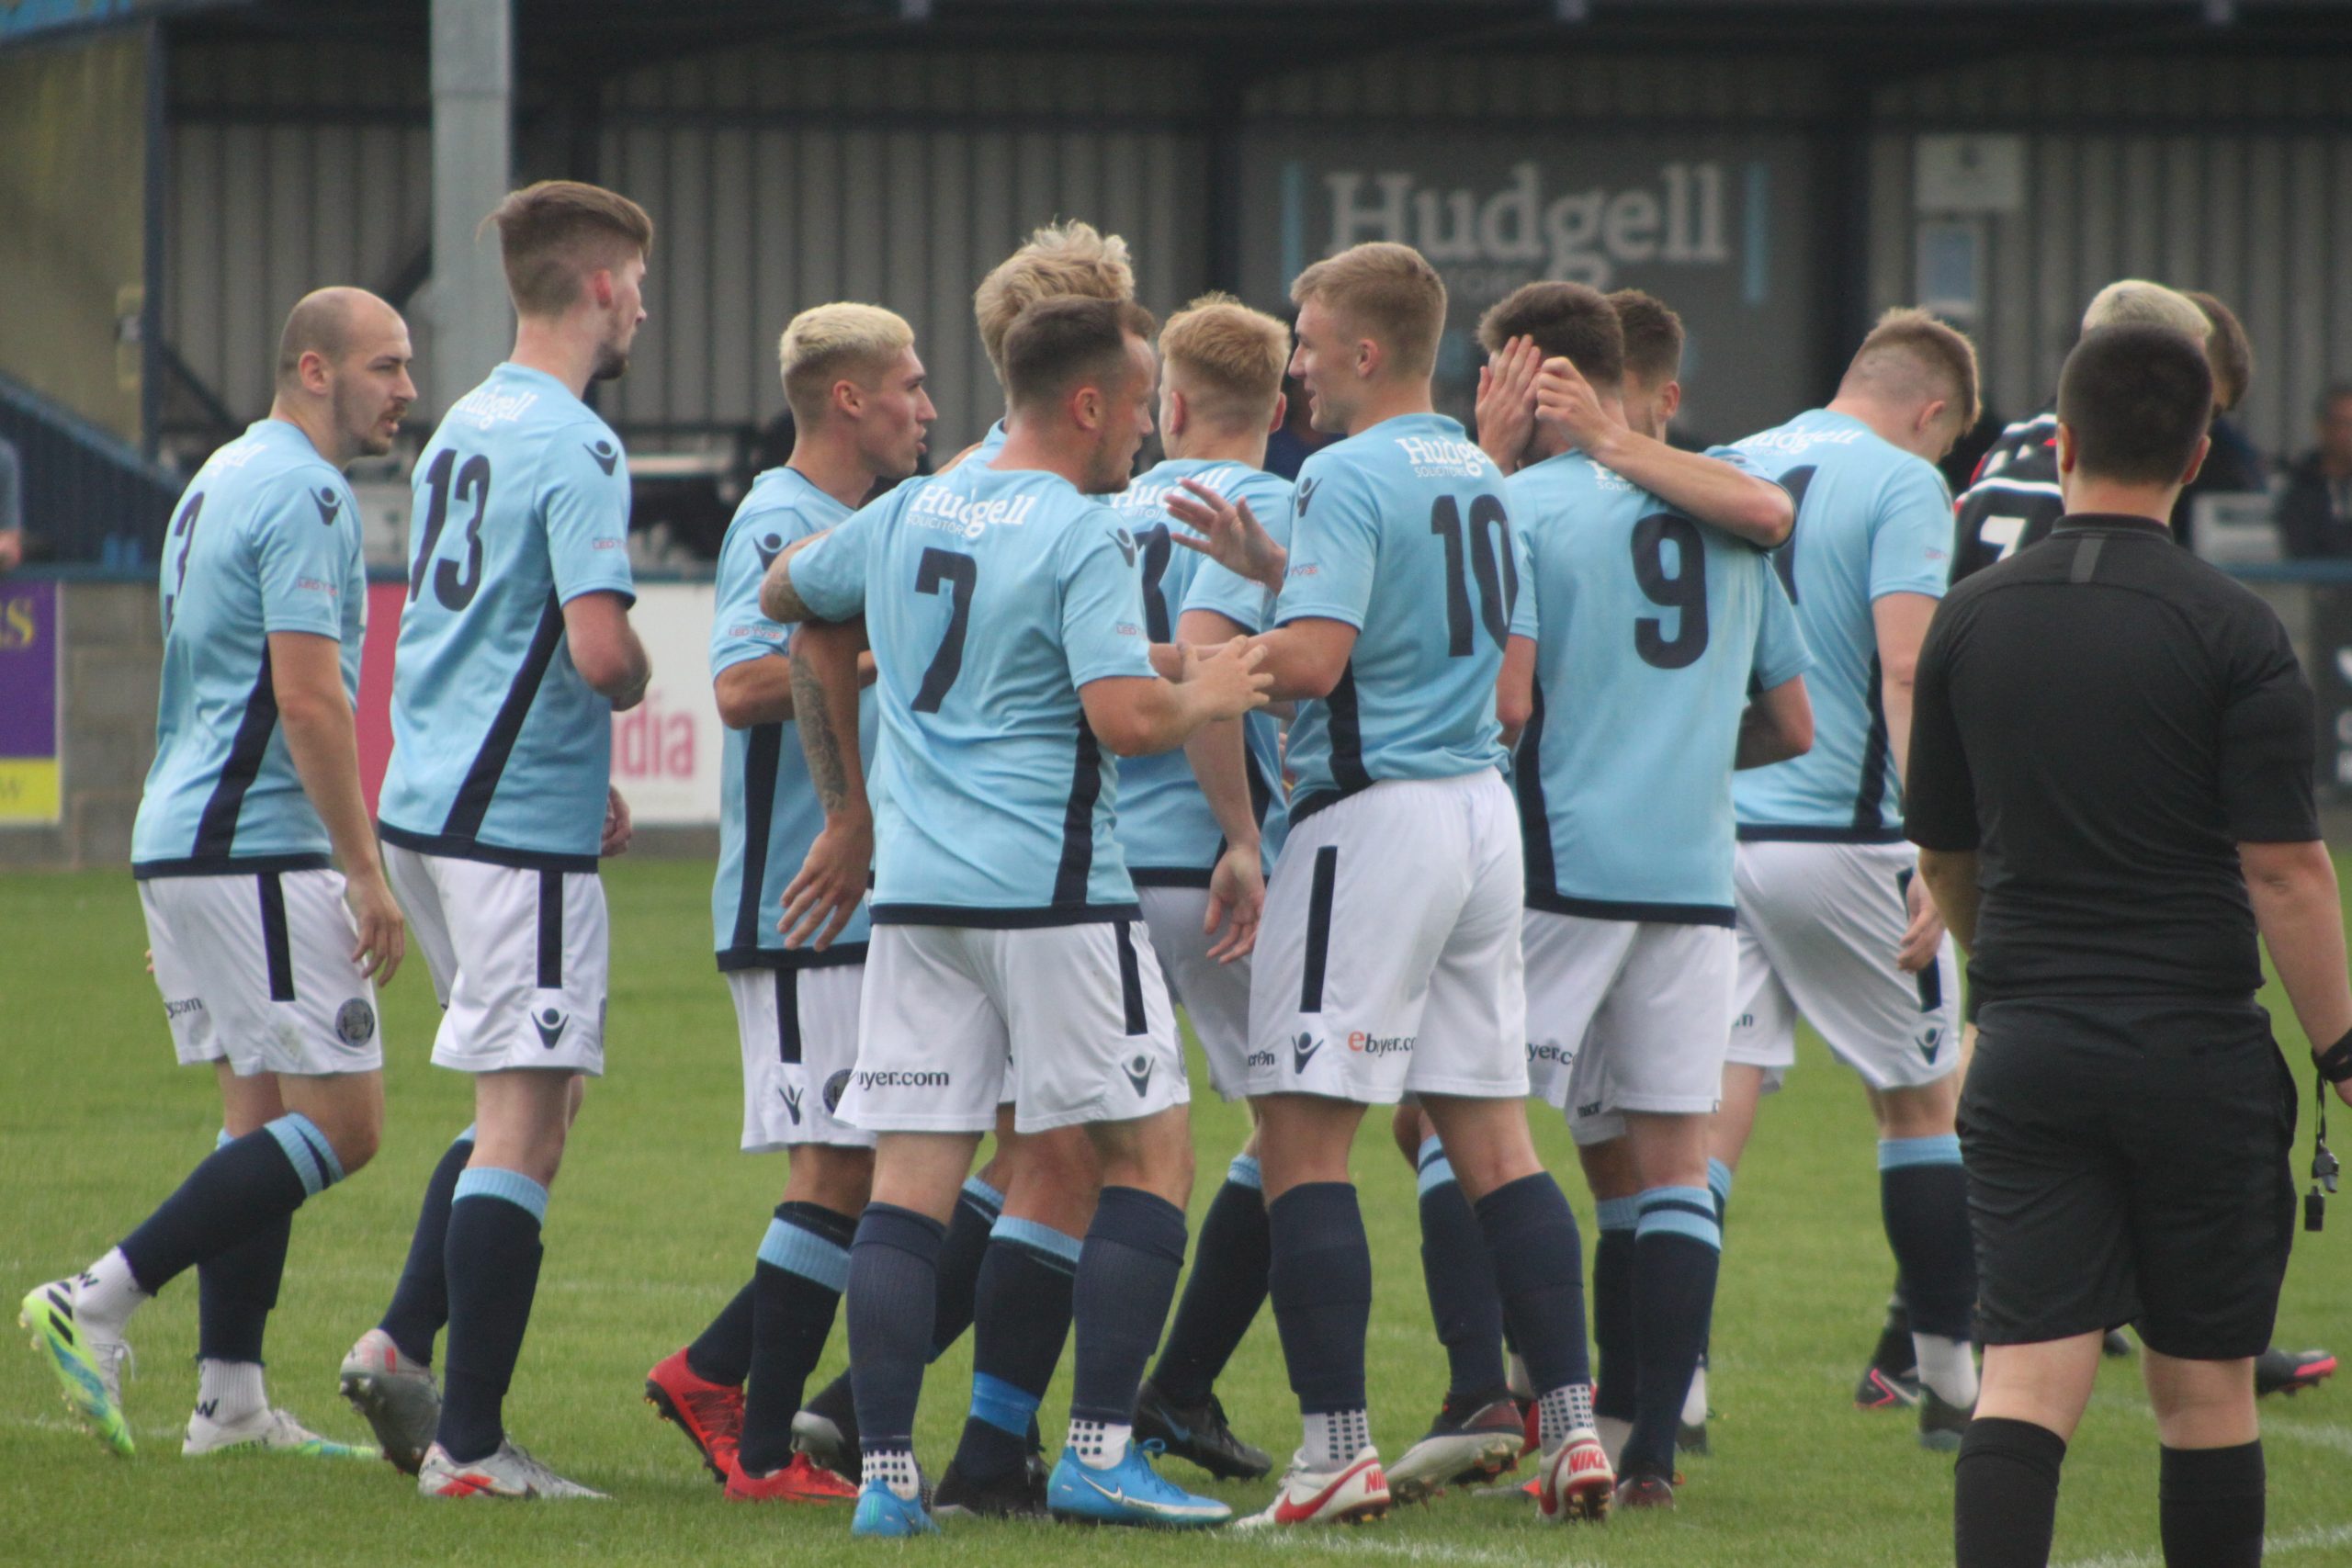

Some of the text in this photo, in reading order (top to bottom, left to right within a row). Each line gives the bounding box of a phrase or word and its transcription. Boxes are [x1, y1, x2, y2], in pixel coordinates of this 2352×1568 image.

[1323, 162, 1729, 292] Hudgell
[410, 448, 491, 613] 13
[909, 484, 1037, 539] Hudgell
[1430, 493, 1520, 658] 10
[911, 547, 978, 715] 7
[1629, 513, 1710, 670] 9
[611, 691, 696, 780] dia
[1567, 1450, 1606, 1477] NIKE
